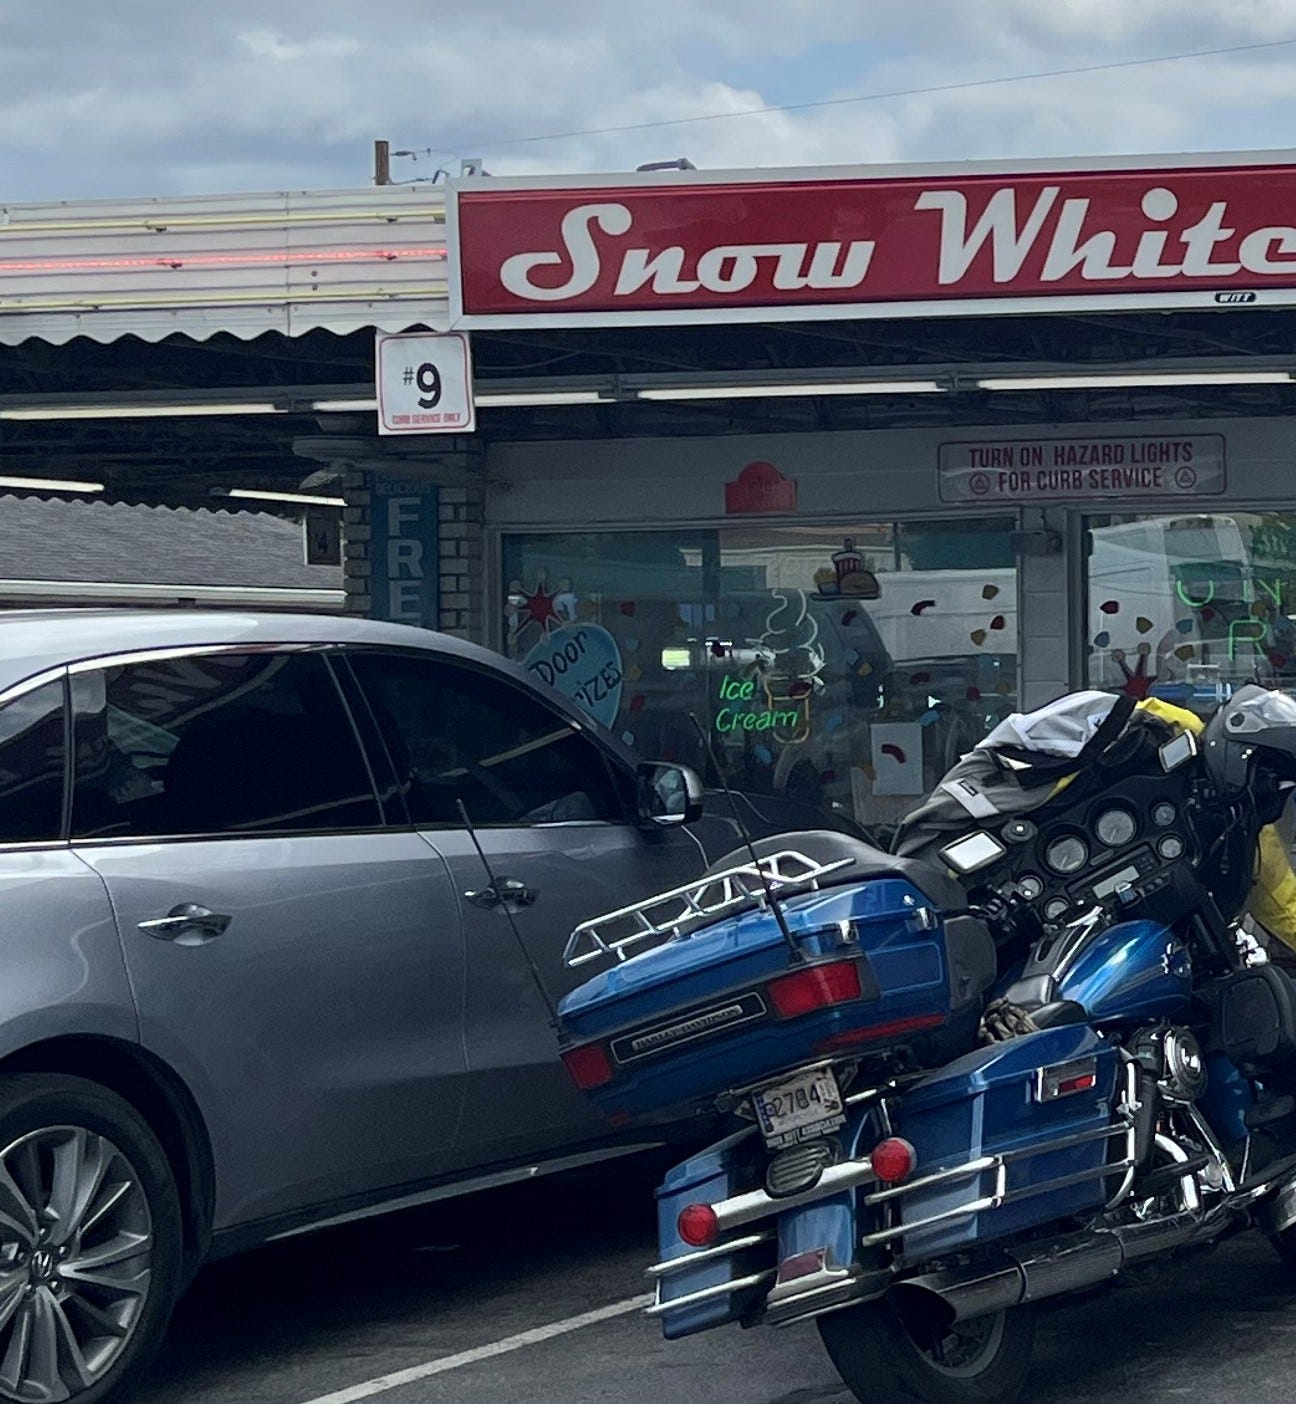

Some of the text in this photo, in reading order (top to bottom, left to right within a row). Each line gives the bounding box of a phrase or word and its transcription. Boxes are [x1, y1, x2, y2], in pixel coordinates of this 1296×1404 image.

[500, 203, 875, 302] Snow
[402, 362, 442, 409] #9
[412, 413, 440, 424] SERVICE
[969, 440, 1193, 469] TURN ON HAZARD LIGHTS
[999, 466, 1163, 493] FOR CURB SERVICE
[720, 674, 756, 701] Ice
[716, 707, 799, 732] Cream
